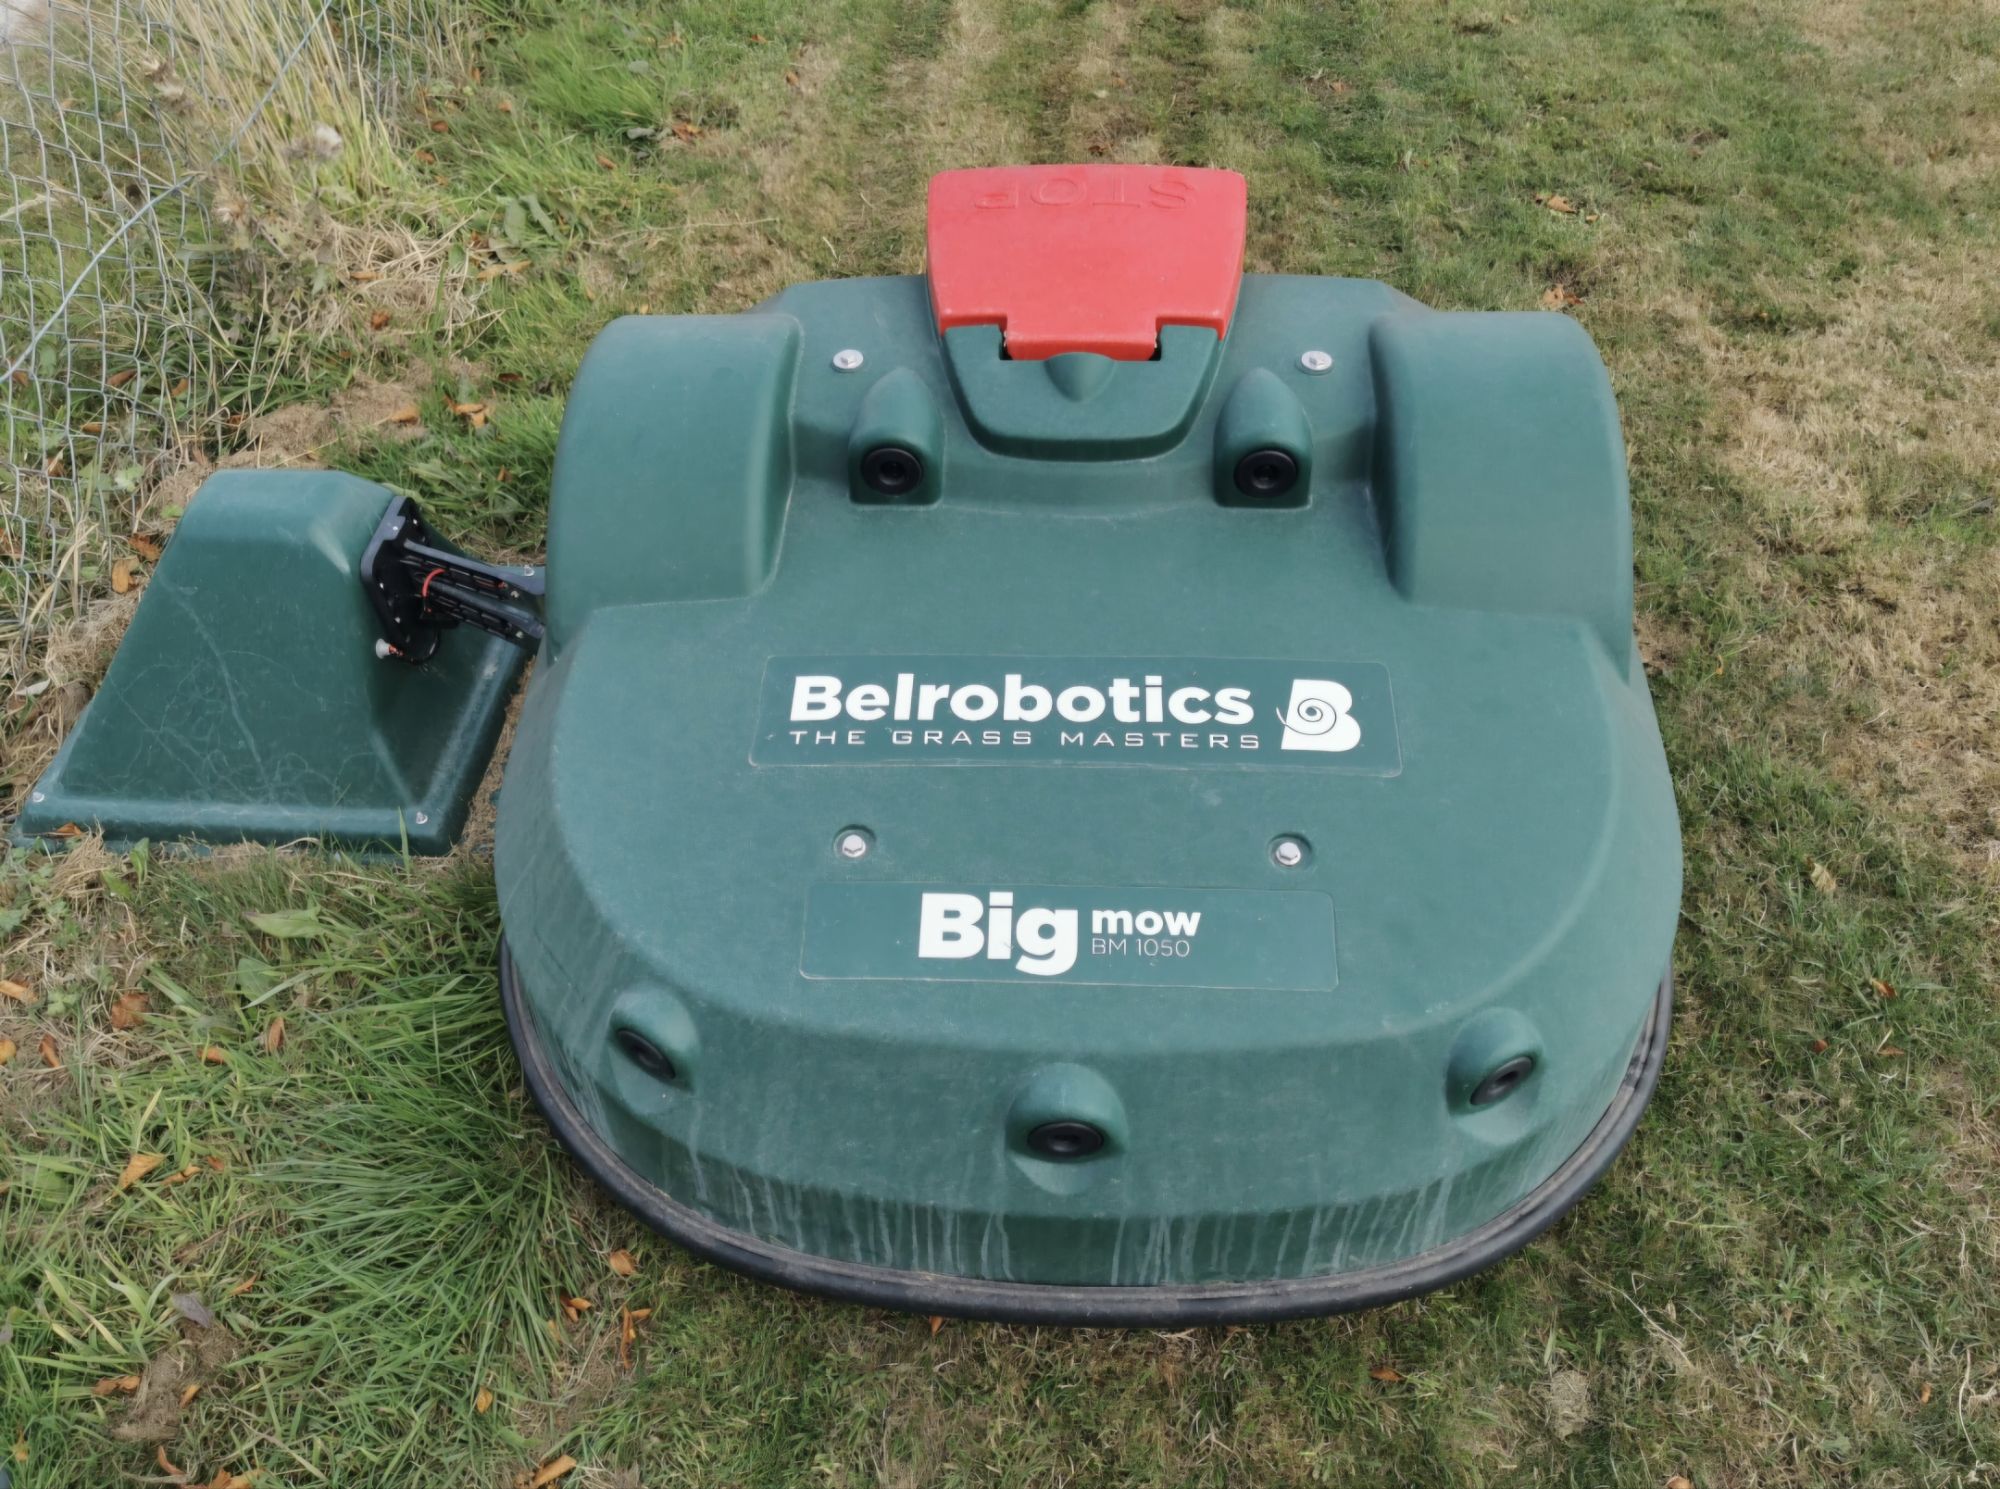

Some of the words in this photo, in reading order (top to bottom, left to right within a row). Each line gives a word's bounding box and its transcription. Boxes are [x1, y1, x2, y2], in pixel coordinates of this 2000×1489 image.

[789, 673, 1255, 725] Belrobotics
[789, 730, 866, 745] THE
[892, 730, 1032, 746] GRASS
[1060, 731, 1260, 749] MASTERS
[918, 891, 1079, 976] Big
[1092, 909, 1202, 937] mow
[1091, 938, 1127, 956] BM
[1135, 938, 1191, 958] 1050
